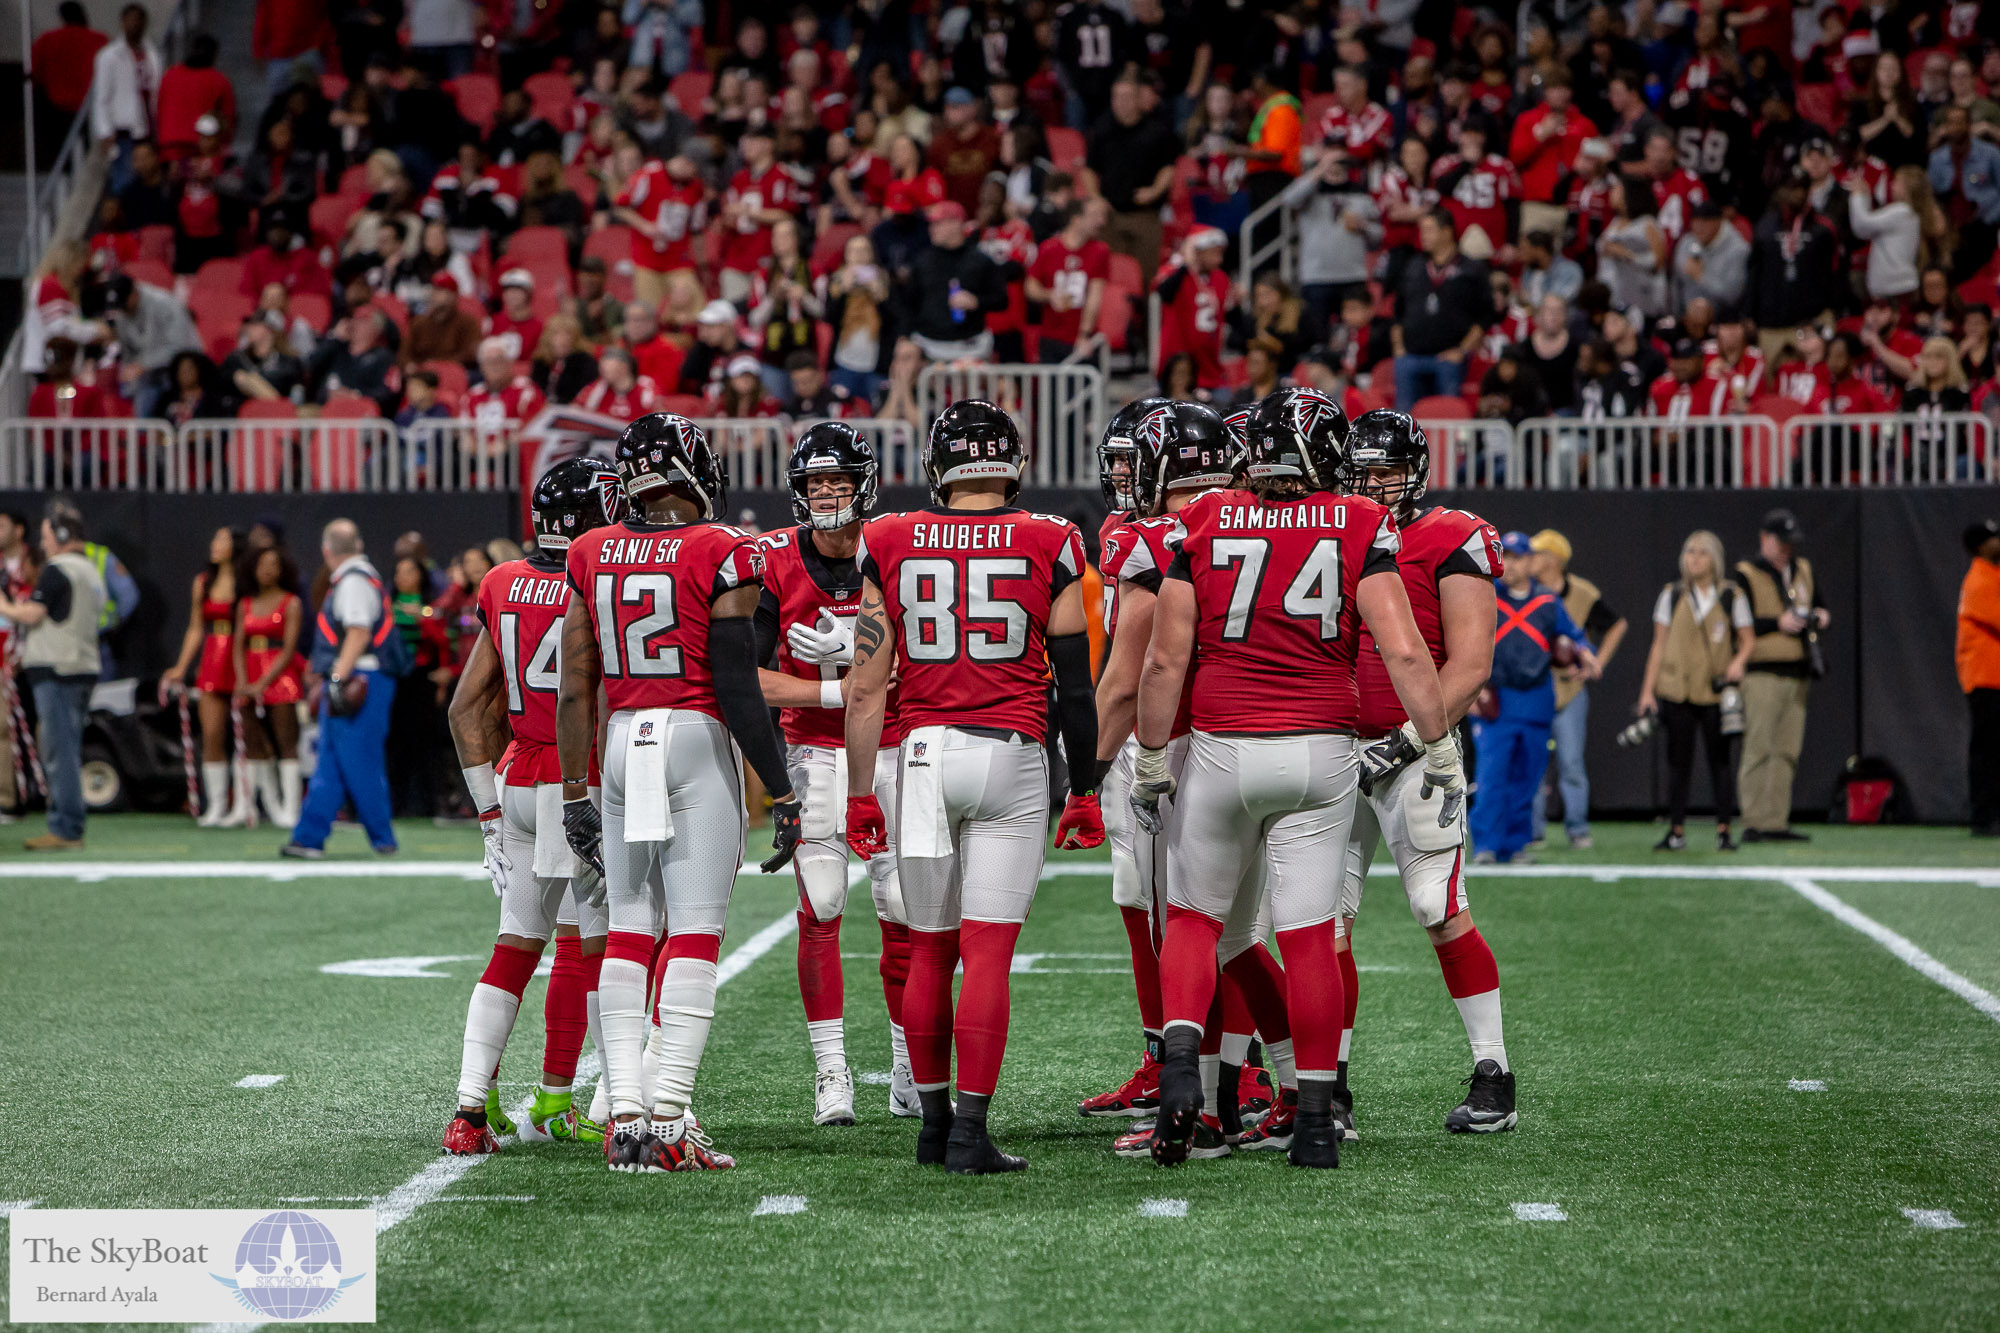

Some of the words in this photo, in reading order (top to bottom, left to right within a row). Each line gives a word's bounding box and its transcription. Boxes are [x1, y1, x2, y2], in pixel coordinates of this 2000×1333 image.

[1677, 127, 1728, 173] 58
[1453, 172, 1496, 209] 45
[968, 440, 997, 456] 85
[1201, 449, 1225, 466] 63
[628, 457, 651, 478] 12
[960, 466, 1008, 475] FALCONS
[542, 518, 561, 535] 14
[1218, 503, 1347, 531] SAMBRAILO
[599, 537, 655, 565] SANU
[654, 538, 684, 565] SR
[912, 523, 1016, 551] SAUBERT
[508, 576, 570, 606] HARDY
[1210, 536, 1345, 643] 74
[898, 557, 1033, 664] 85
[595, 571, 686, 680] 12
[500, 611, 564, 717] 14
